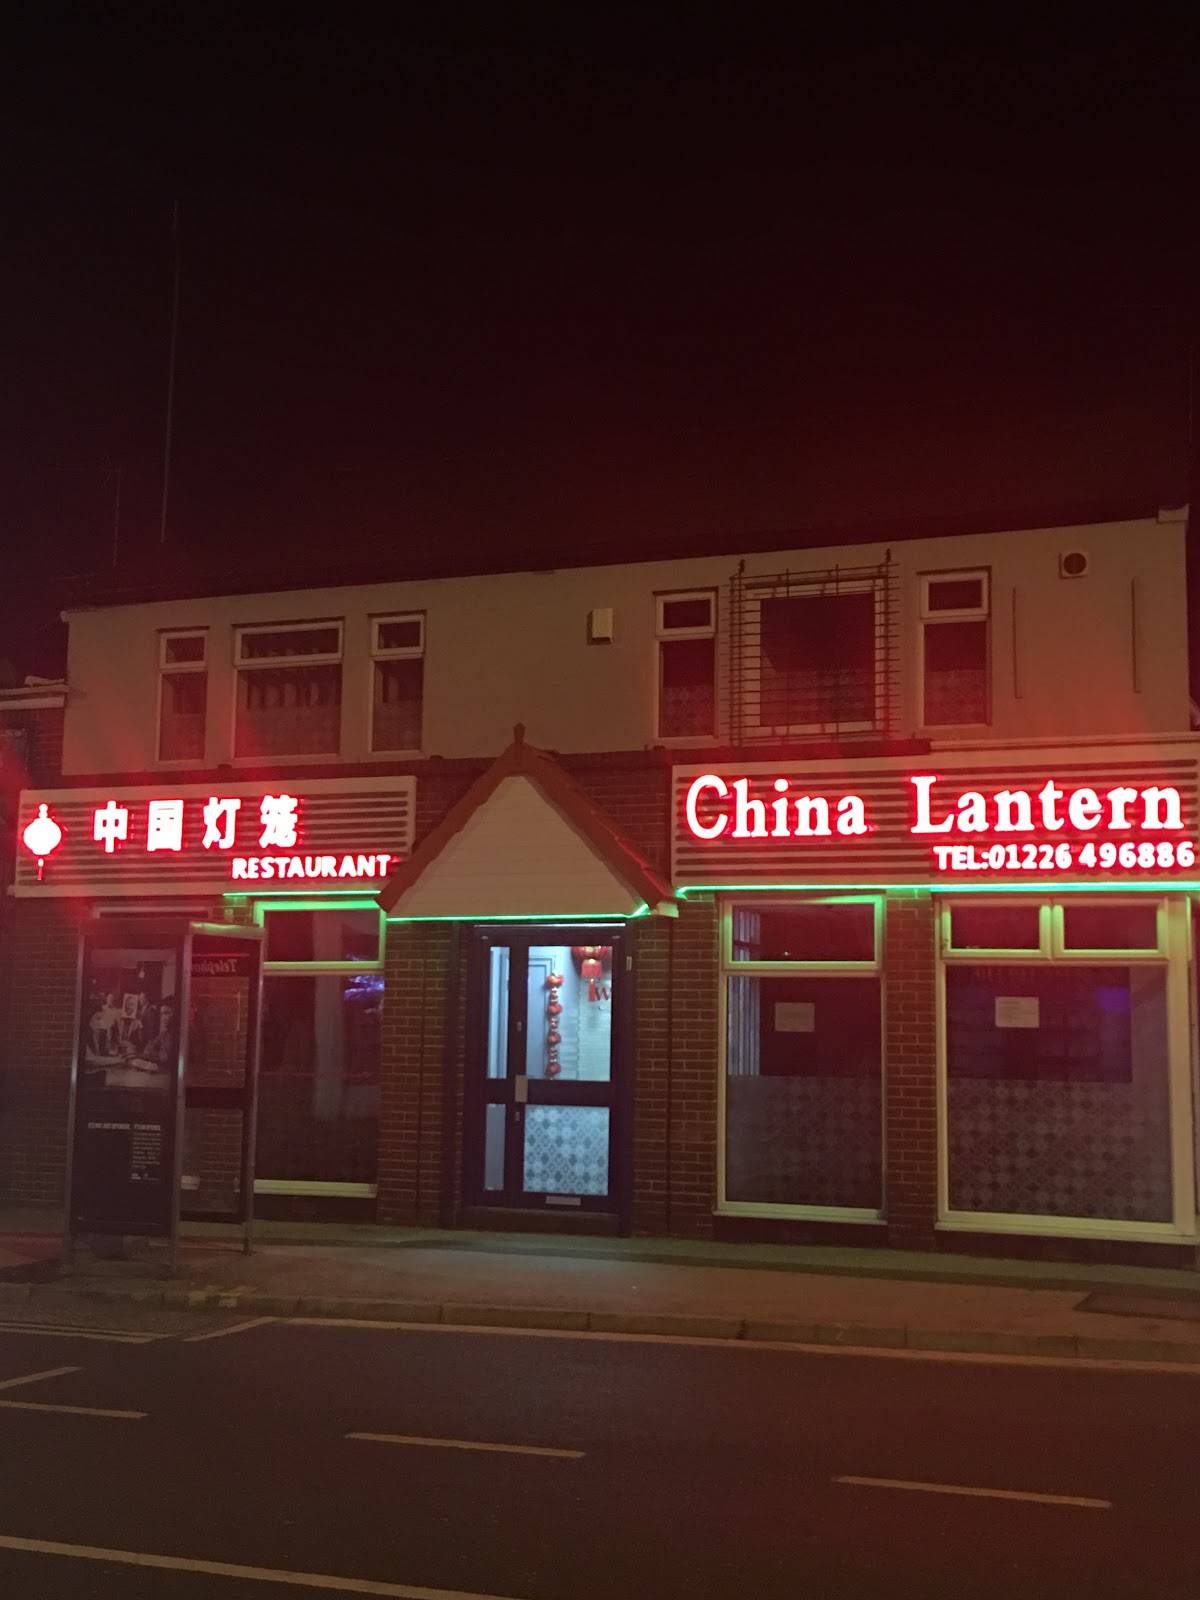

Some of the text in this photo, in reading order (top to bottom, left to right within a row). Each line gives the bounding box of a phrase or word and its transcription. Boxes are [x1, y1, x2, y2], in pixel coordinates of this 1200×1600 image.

[93, 795, 298, 852] 中国灯笼
[687, 775, 1184, 838] China Lantern
[232, 854, 391, 879] RESTAURANT
[933, 841, 1195, 869] TEL:01226 496886
